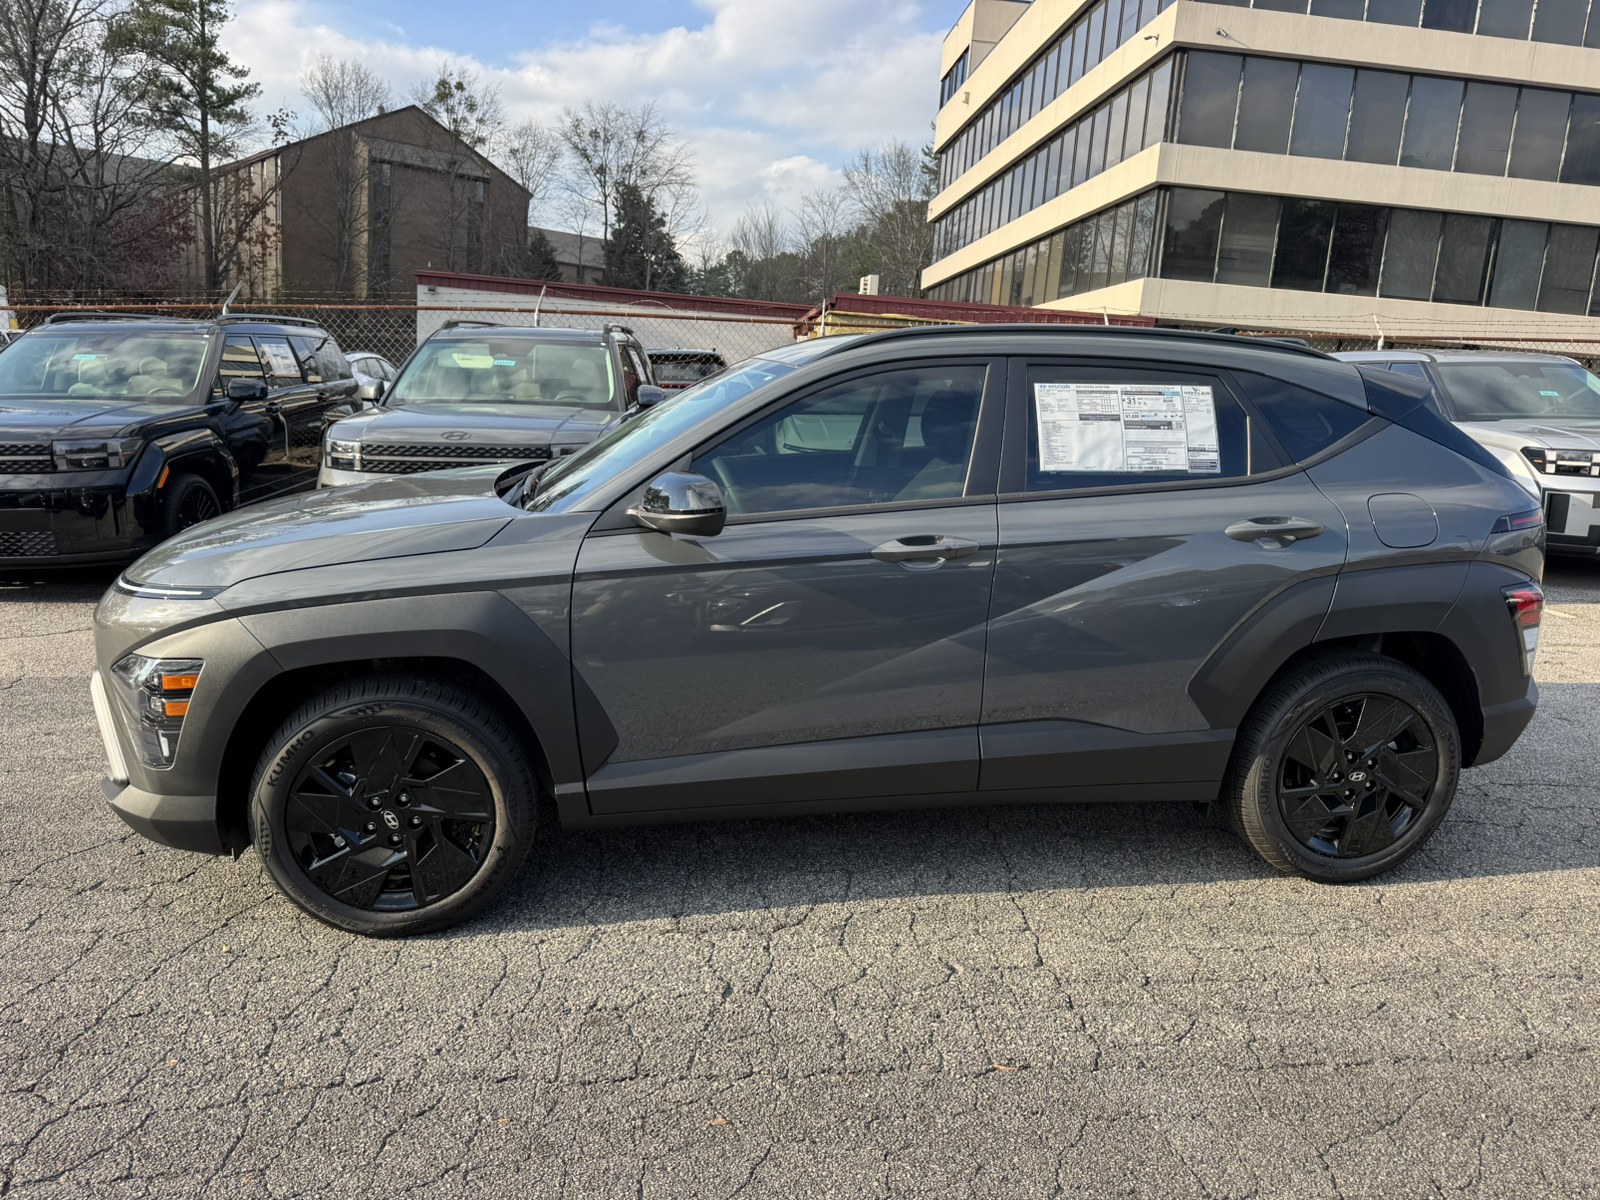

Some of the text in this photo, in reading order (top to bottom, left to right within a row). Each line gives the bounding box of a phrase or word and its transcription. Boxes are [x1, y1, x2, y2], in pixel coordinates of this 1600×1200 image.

[1127, 397, 1136, 405] 31
[267, 730, 315, 788] KUMHO
[1260, 757, 1273, 815] KUMHO
[1447, 732, 1457, 787] SOLUS
[472, 845, 512, 900] SOLUS
